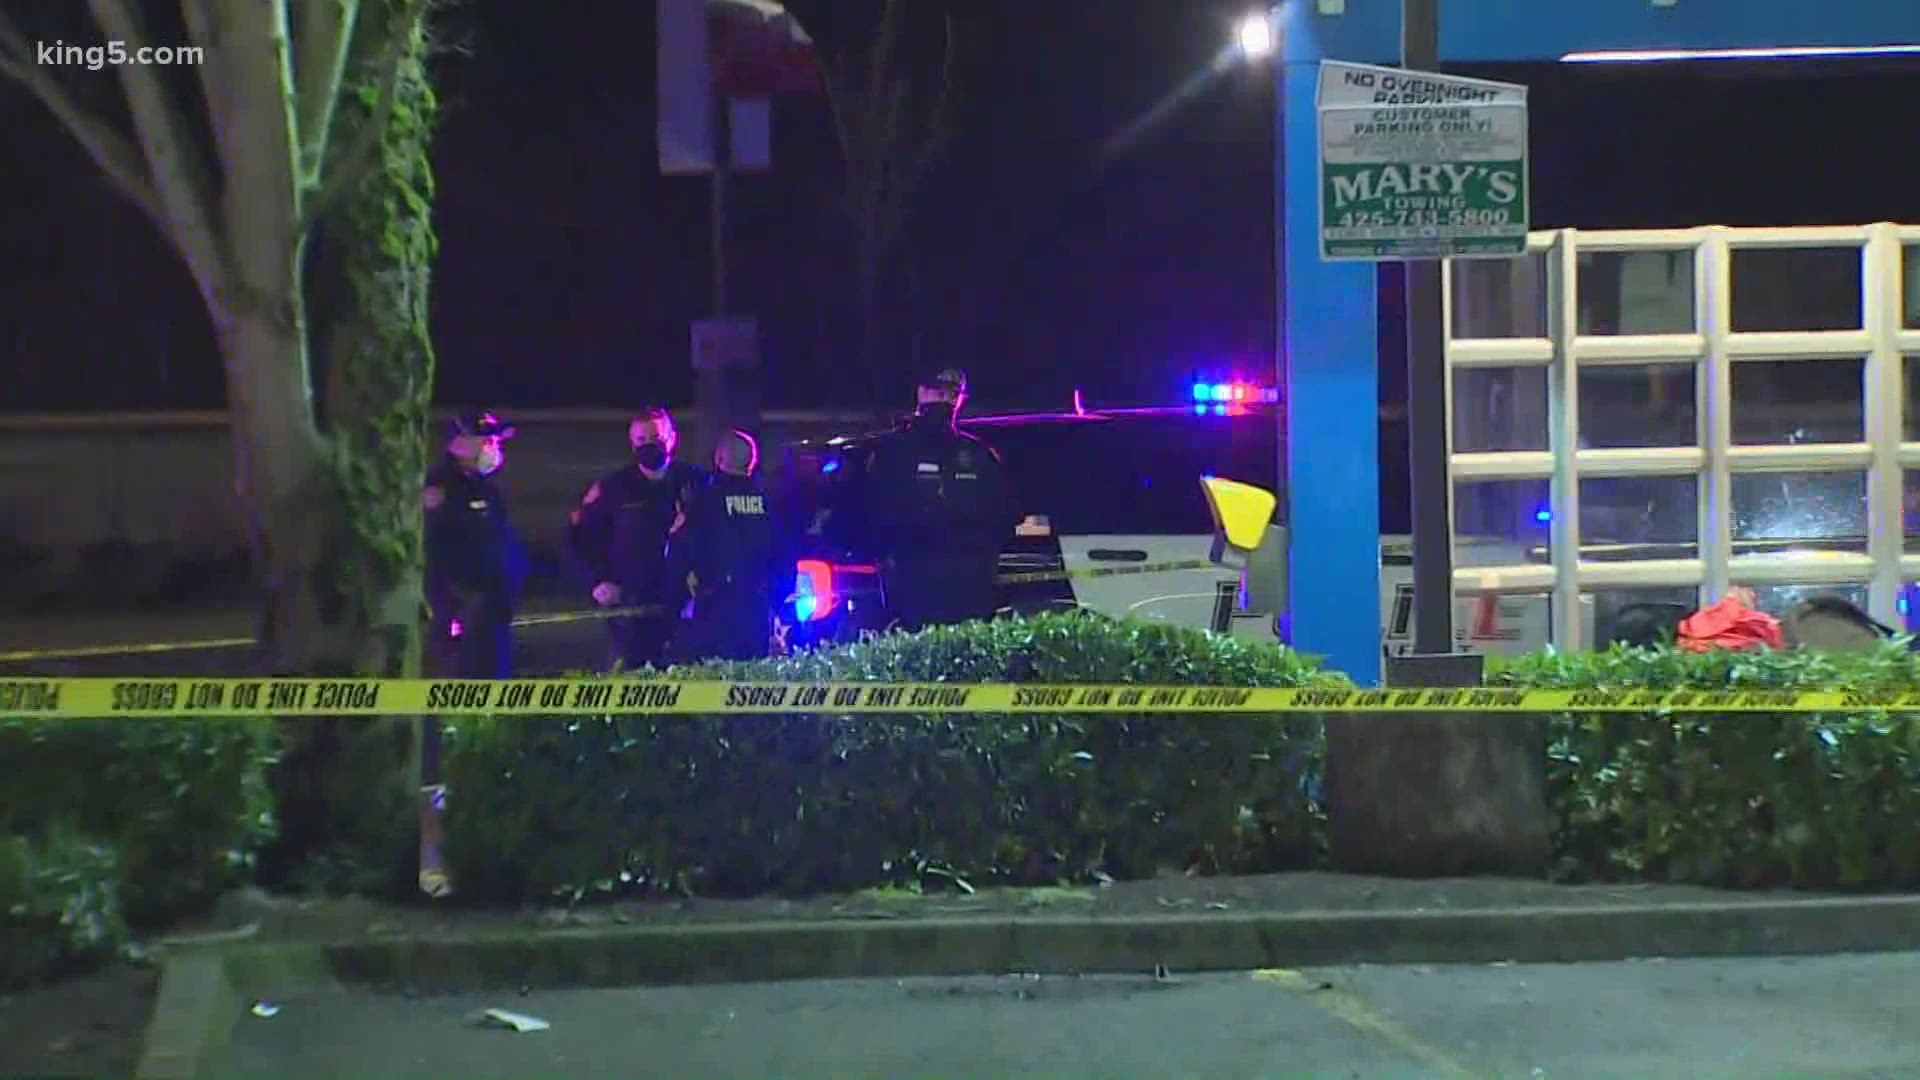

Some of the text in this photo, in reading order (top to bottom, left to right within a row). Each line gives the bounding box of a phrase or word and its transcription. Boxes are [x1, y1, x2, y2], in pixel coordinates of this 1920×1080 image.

[1344, 72, 1499, 103] NO OVERNIGHT
[1373, 108, 1471, 121] CUSTOMER
[1354, 117, 1492, 134] PARKING ONLY!
[1331, 164, 1518, 208] MARY'S
[1384, 197, 1466, 209] TOWING
[1339, 209, 1509, 226] 425-743-5800
[725, 495, 765, 515] POLICE
[112, 683, 380, 709] POLICE LINE DO NOT CROSS
[427, 684, 681, 707] POLICE LINE DO NOT CROSS
[725, 686, 969, 706] POLICE LINE DO NOT CROSS
